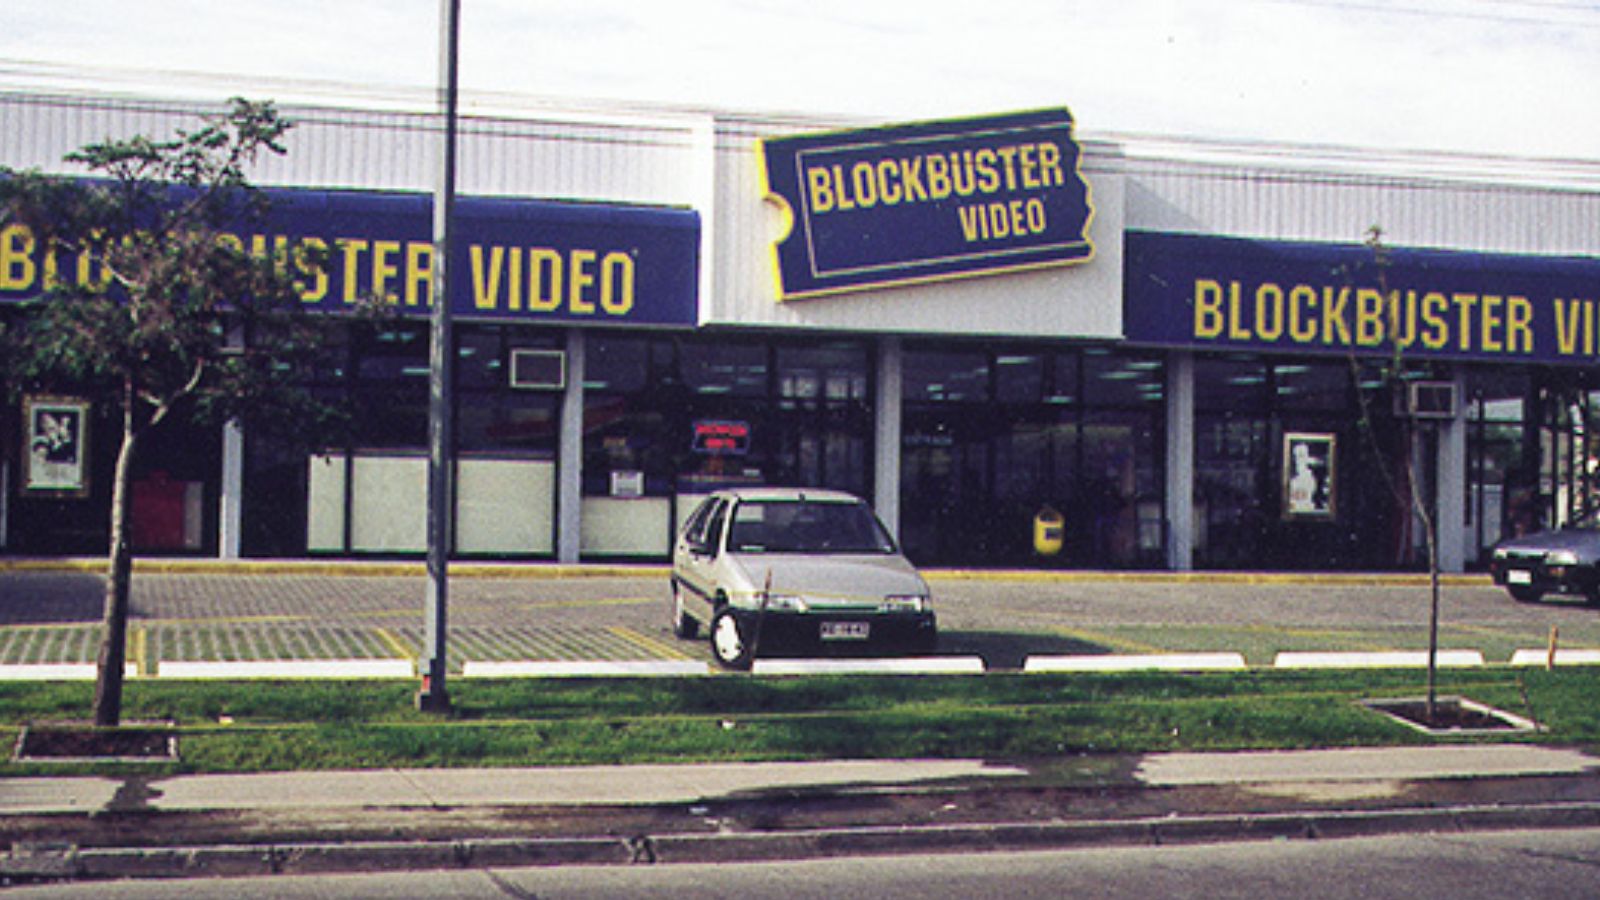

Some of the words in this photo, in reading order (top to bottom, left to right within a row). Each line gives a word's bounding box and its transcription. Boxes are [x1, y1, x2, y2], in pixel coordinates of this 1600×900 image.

[807, 142, 1065, 214] BLOCKBUSTER
[959, 198, 1047, 242] VIDEO
[471, 244, 635, 315] VIDEO
[1194, 279, 1534, 353] BLOCKBUSTER
[1554, 298, 1600, 356] VI
